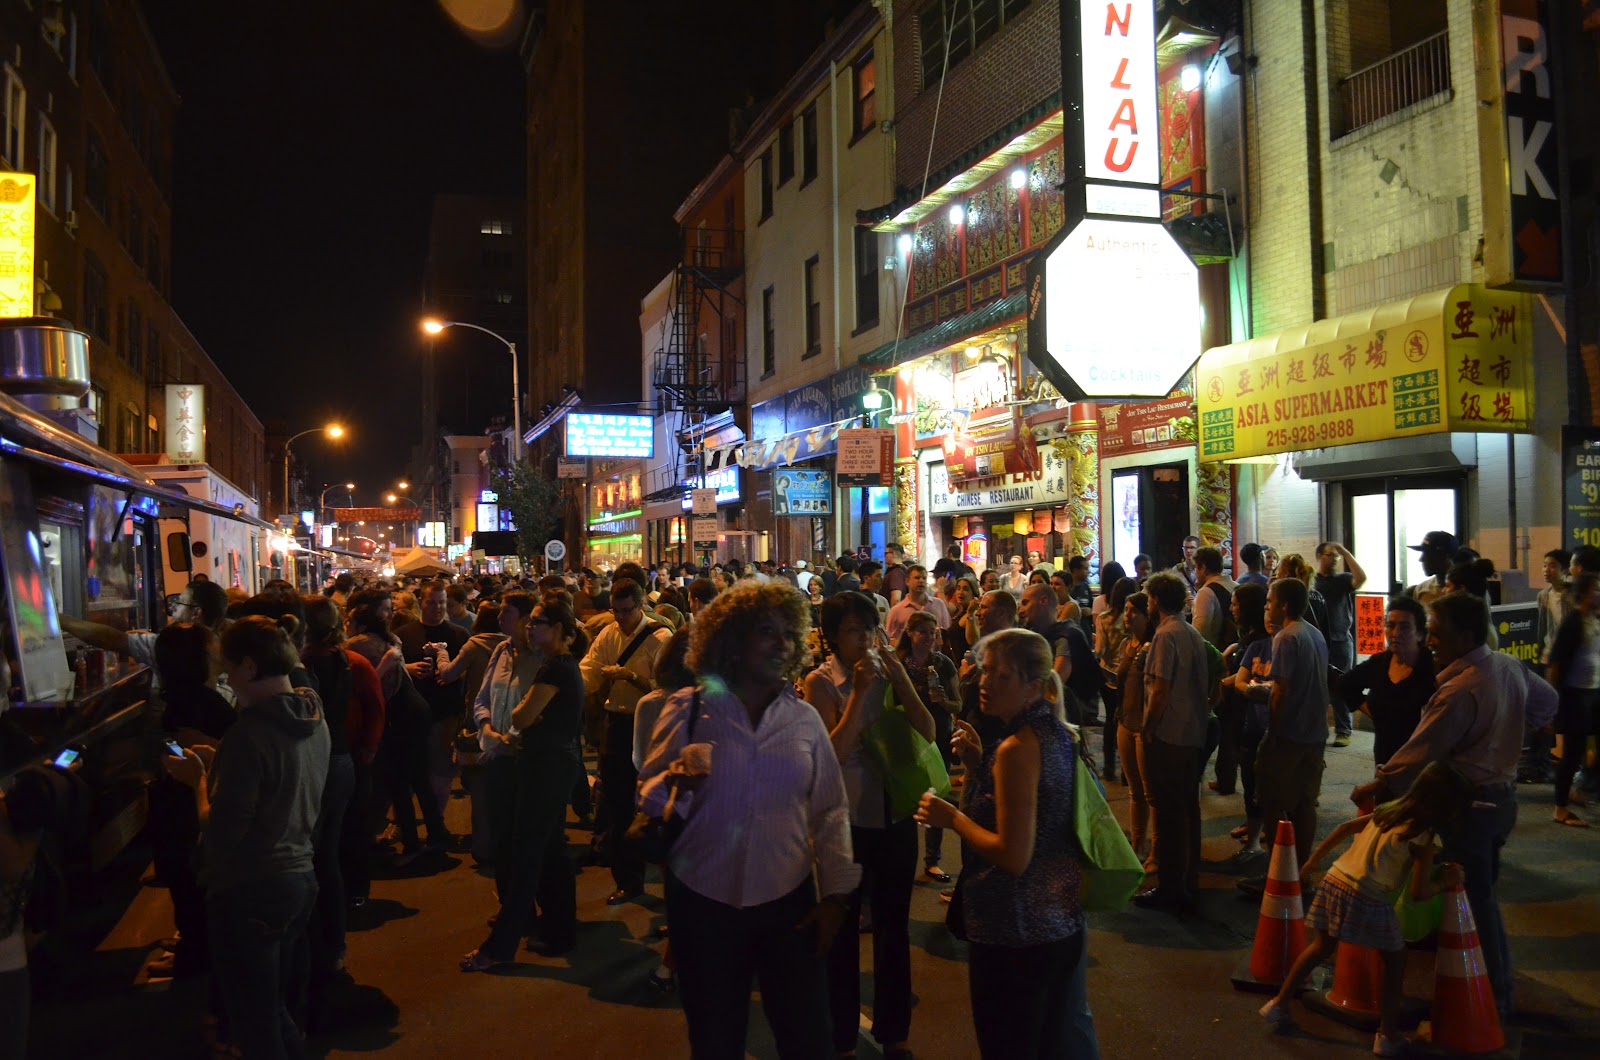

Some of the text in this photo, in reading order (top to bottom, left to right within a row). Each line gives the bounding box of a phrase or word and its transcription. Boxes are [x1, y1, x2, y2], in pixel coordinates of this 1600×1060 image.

[1104, 57, 1139, 173] LAU
[19, 211, 32, 273] OCEAN
[1086, 235, 1161, 254] Authentic
[18, 281, 31, 317] HAR
[1089, 365, 1161, 383] Cocktails
[1237, 379, 1388, 429] ASIA SUPERMARKET
[1267, 418, 1354, 447] 215-928-9888
[957, 486, 1034, 507] CHINESE RESTAURANT
[1510, 620, 1531, 629] Central
